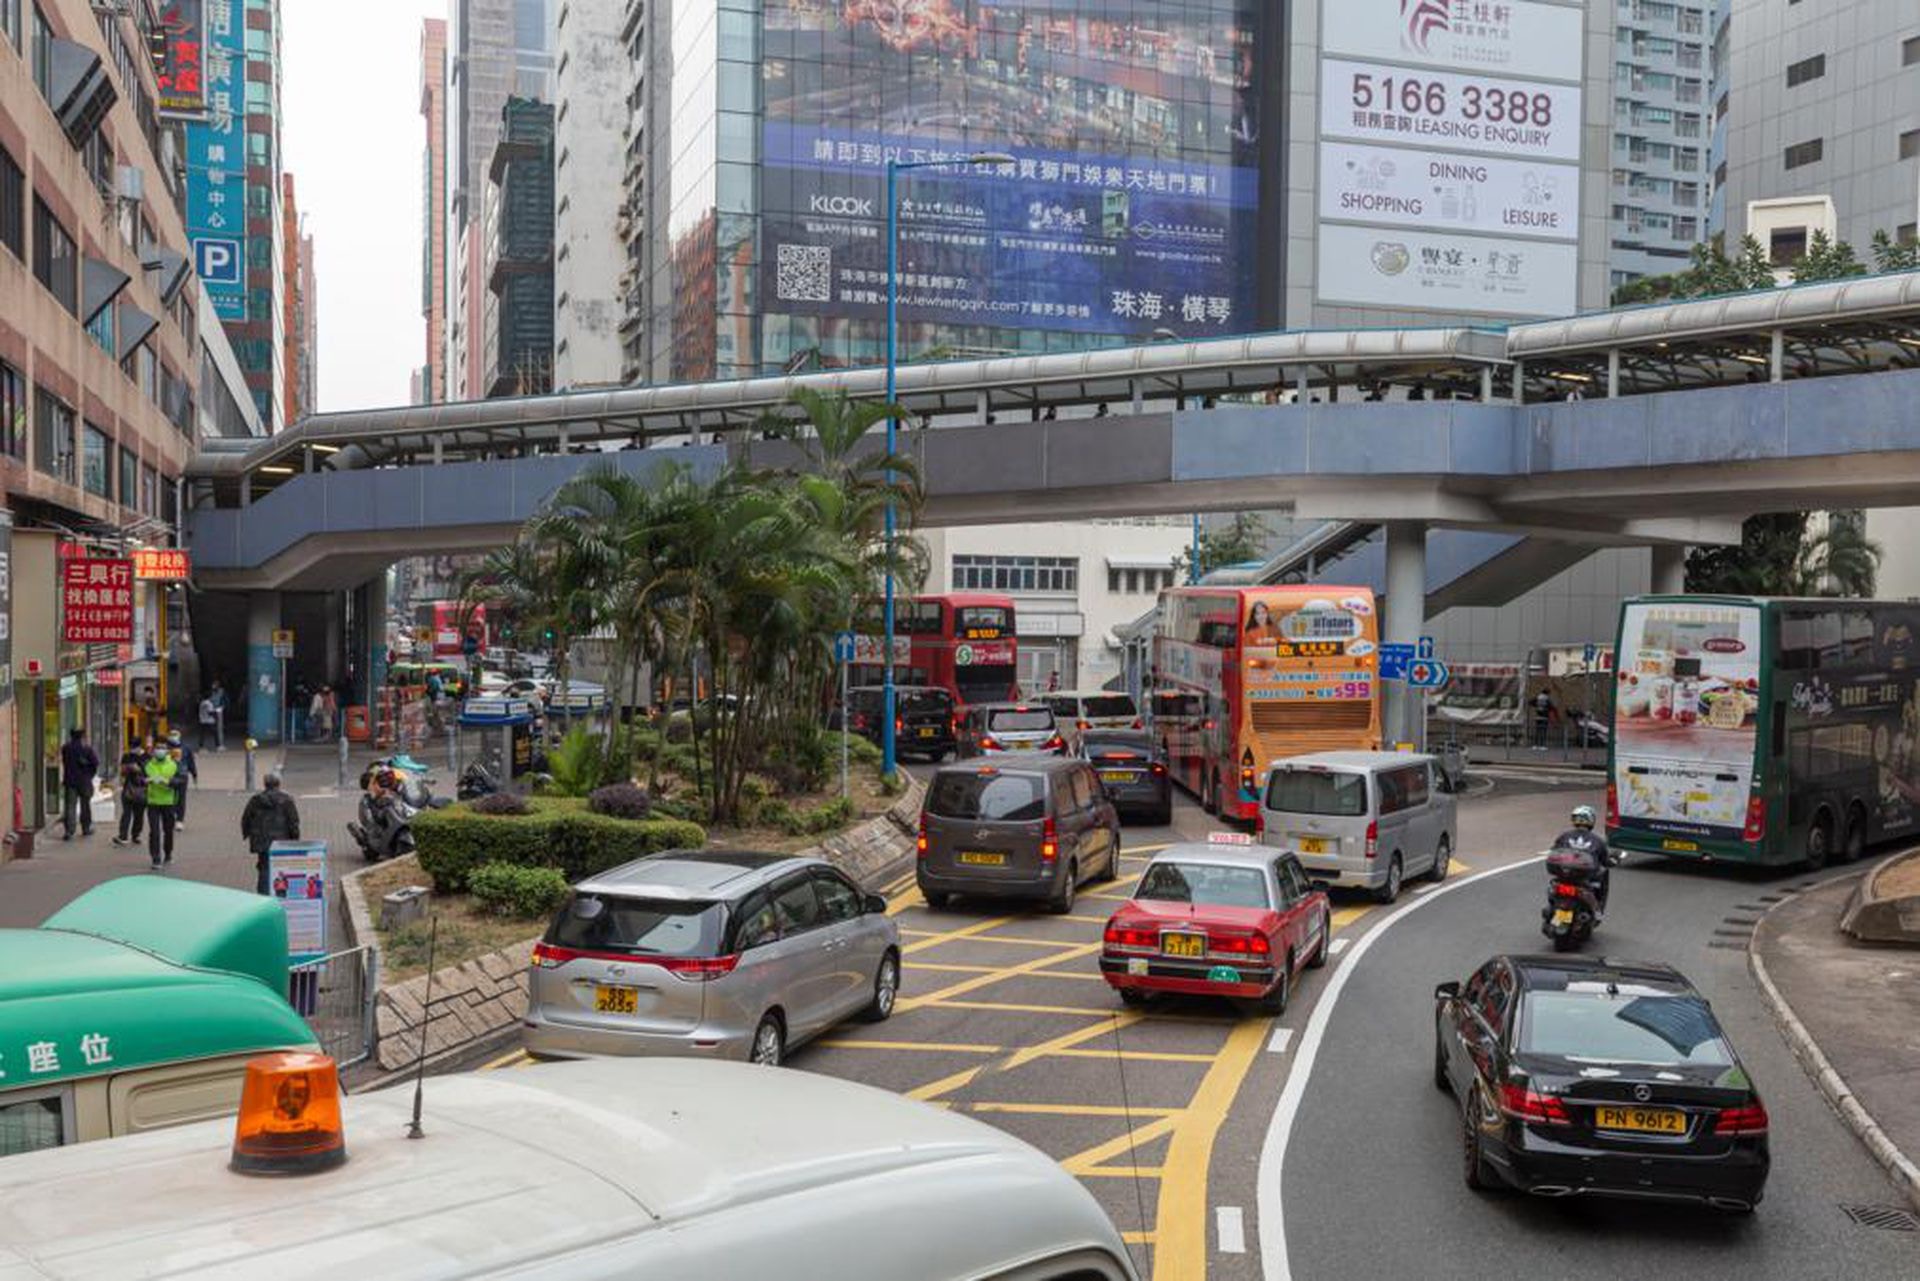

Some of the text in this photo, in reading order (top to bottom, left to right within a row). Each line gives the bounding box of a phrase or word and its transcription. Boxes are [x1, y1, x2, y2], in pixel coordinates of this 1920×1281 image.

[1352, 73, 1552, 127] 5166 3388
[1352, 110, 1551, 147] 租務查詢 LEASING ENQUIRY
[1428, 161, 1487, 182] DINING
[810, 195, 872, 216] KLOOK
[1340, 191, 1423, 216] SHOPPING
[1502, 207, 1559, 229] LEISURE
[204, 246, 230, 276] P
[68, 564, 130, 585] 三興行
[0, 1032, 113, 1077] 座位
[1604, 1109, 1677, 1129] PN 9612
